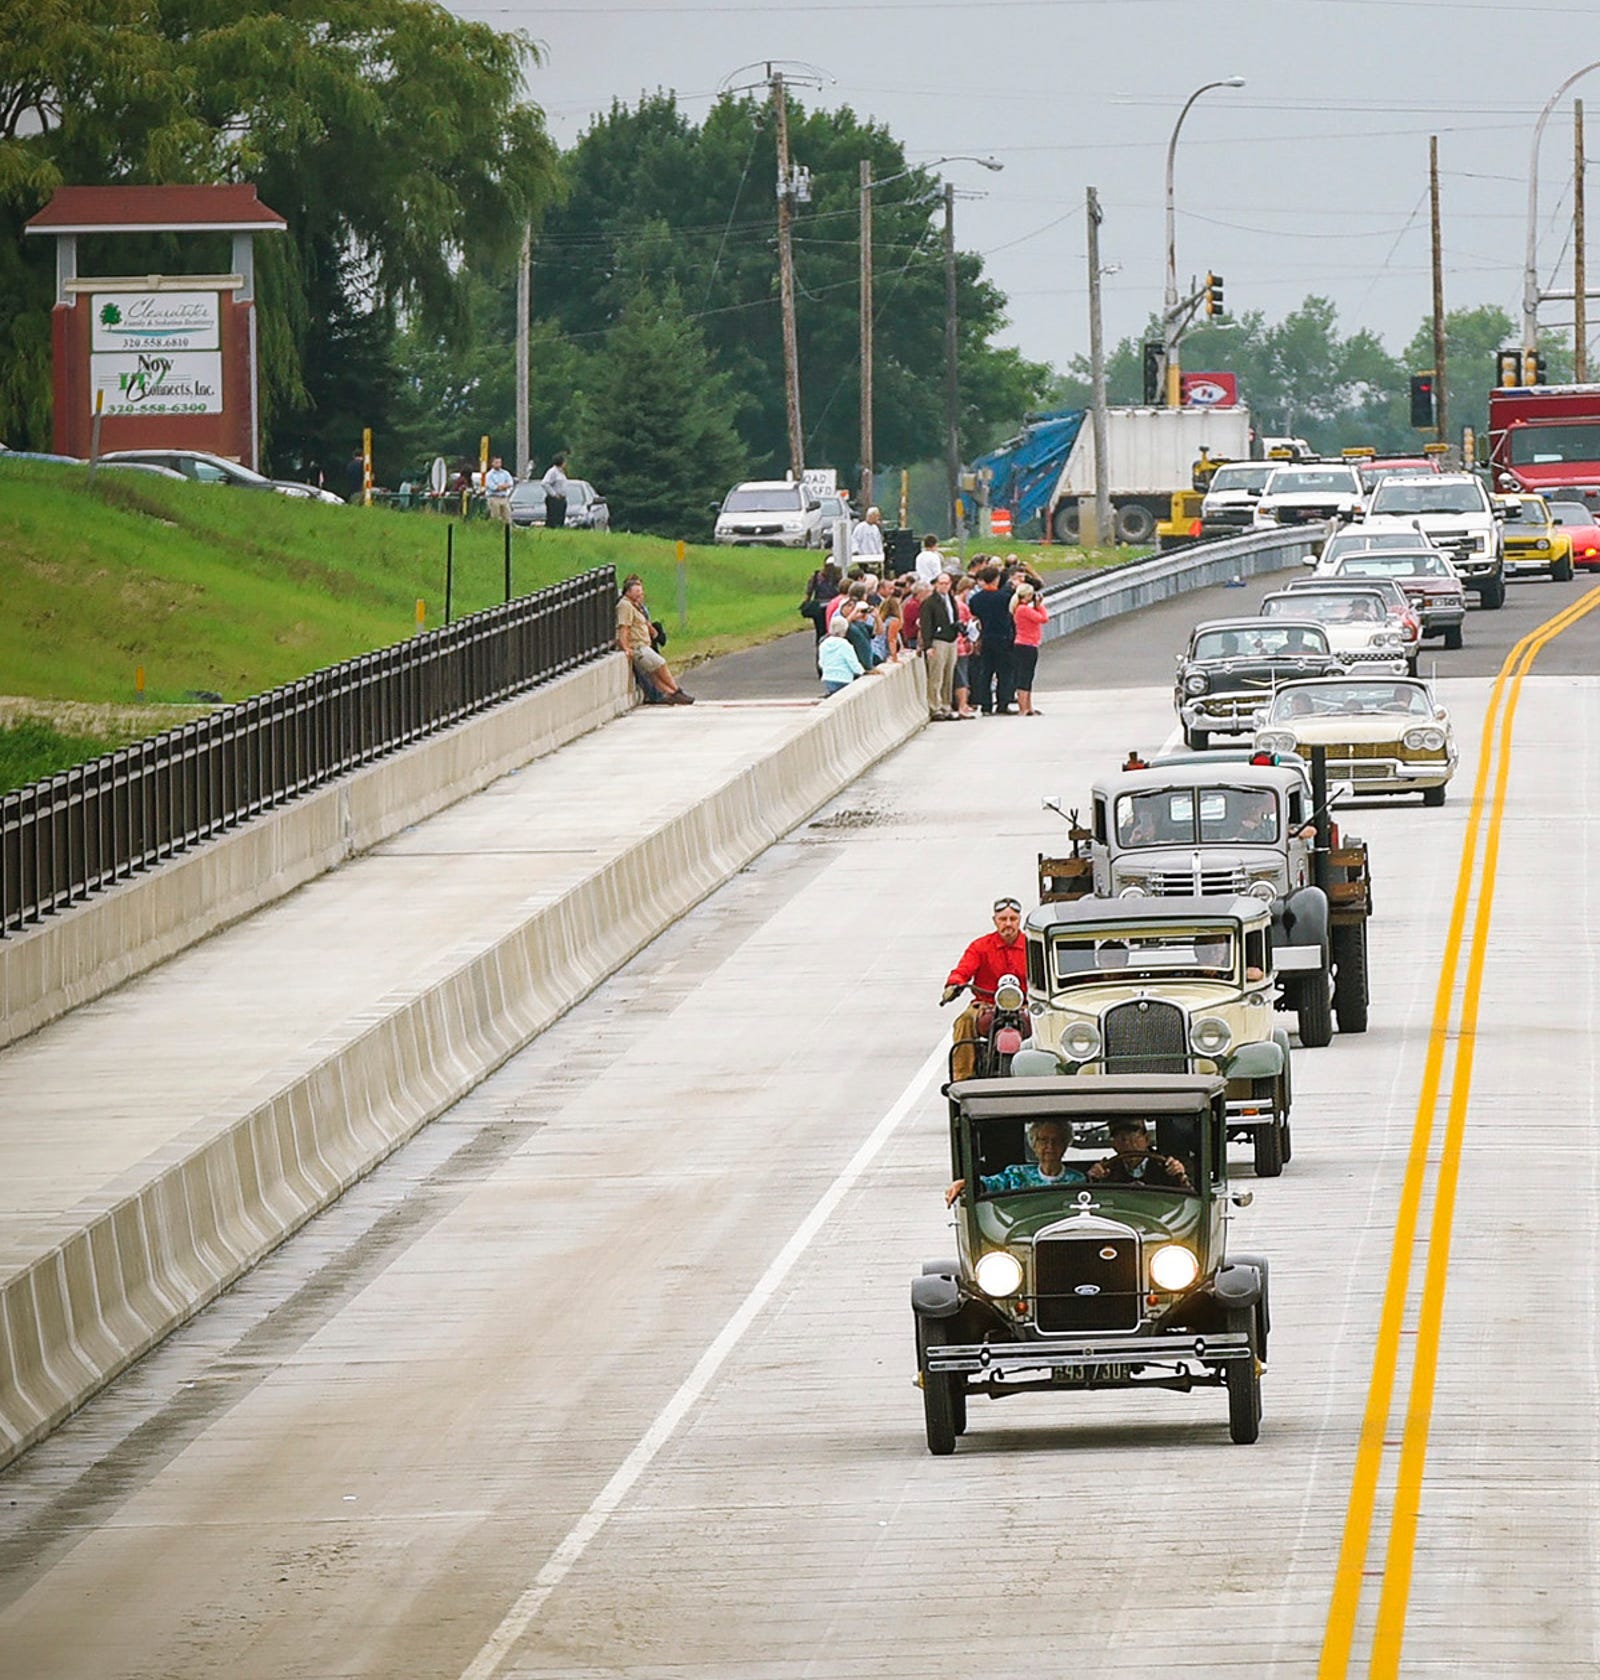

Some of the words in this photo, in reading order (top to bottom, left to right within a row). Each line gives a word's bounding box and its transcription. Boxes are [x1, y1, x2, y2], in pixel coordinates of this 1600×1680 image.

[138, 354, 174, 372] Now
[195, 381, 215, 397] Inc.
[108, 403, 207, 414] 320-558-6300
[804, 475, 826, 484] OAD
